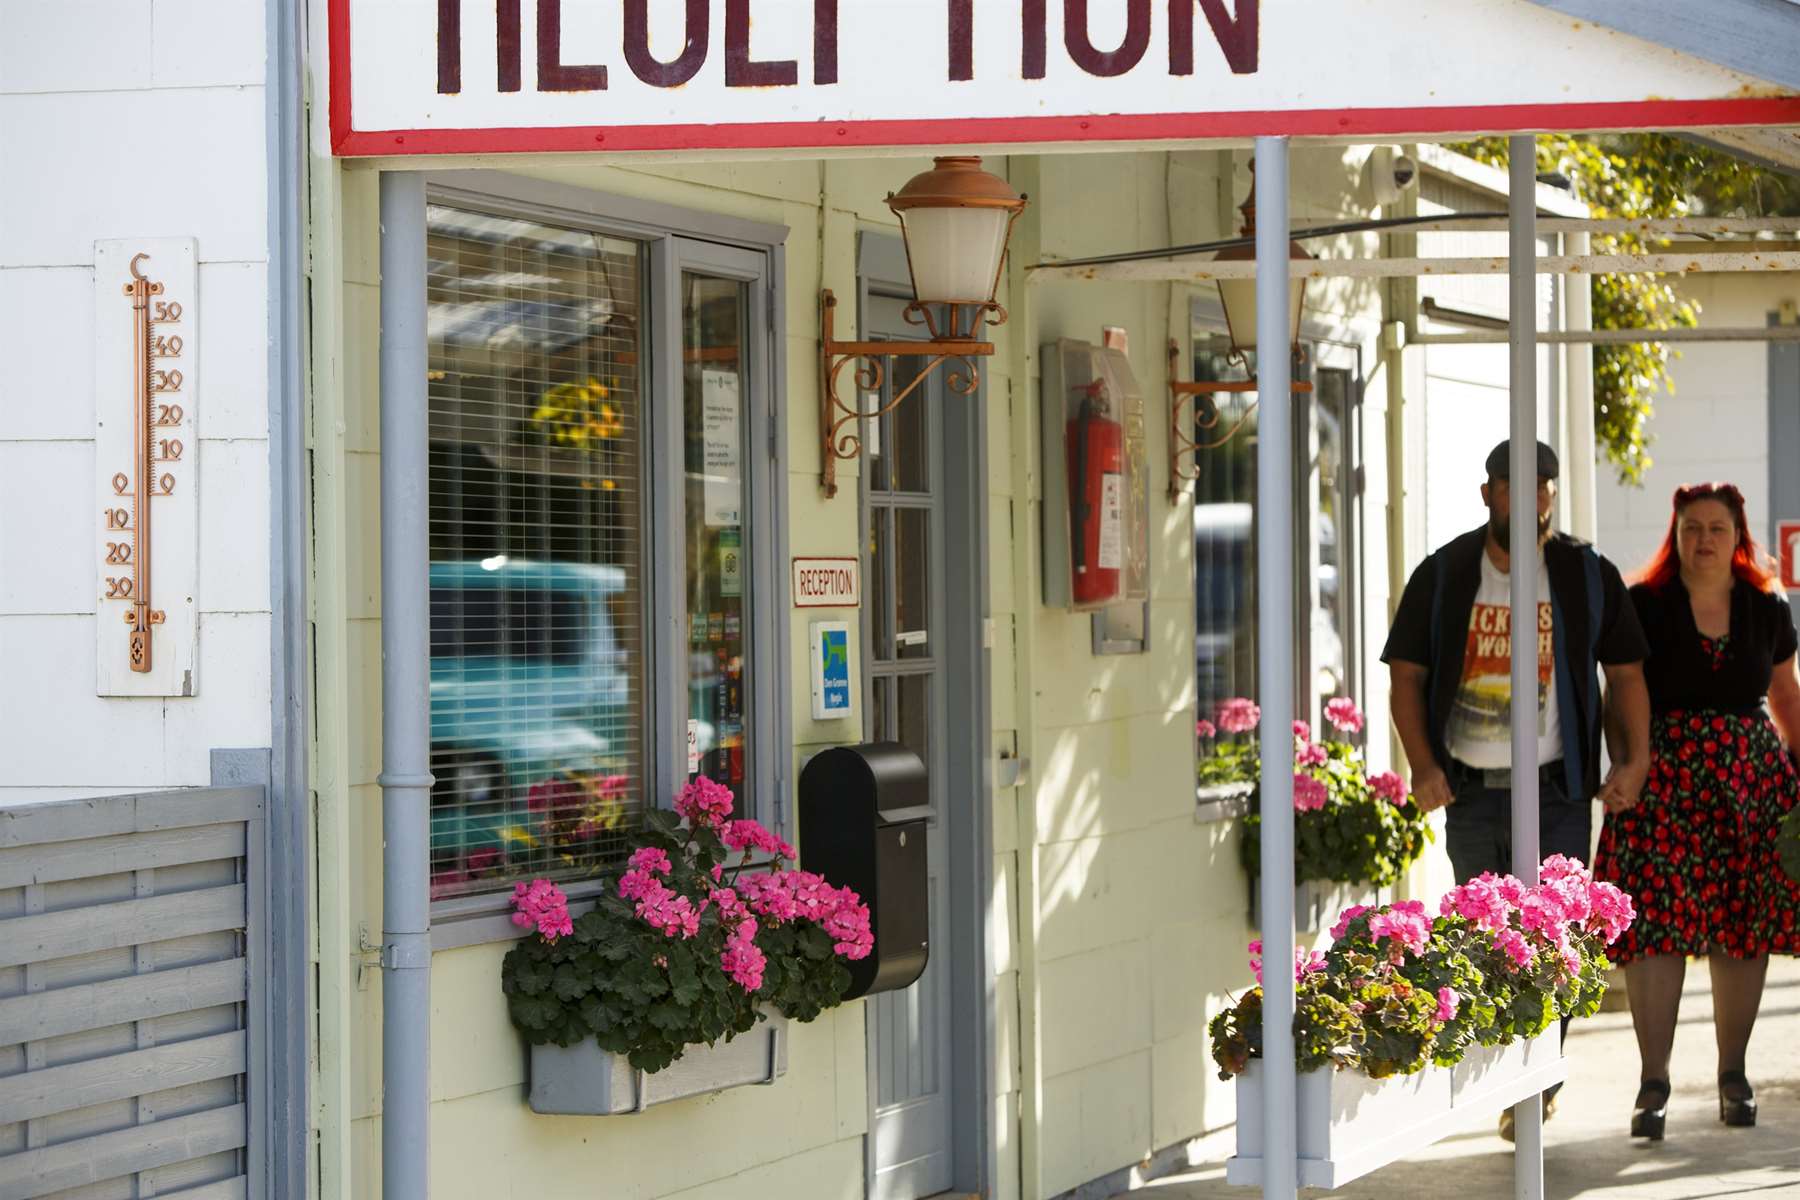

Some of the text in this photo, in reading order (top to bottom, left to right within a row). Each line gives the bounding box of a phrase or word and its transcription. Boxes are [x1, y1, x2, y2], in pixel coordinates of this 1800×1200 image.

[153, 301, 182, 321] 50
[155, 335, 183, 355] 40
[154, 369, 183, 389] 30
[158, 404, 184, 425] 20
[159, 438, 183, 459] 10
[112, 472, 128, 493] 0
[160, 472, 175, 493] 0
[104, 508, 128, 528] 10
[106, 542, 131, 562] 20
[106, 576, 132, 597] 30
[800, 569, 852, 596] RECEPTION
